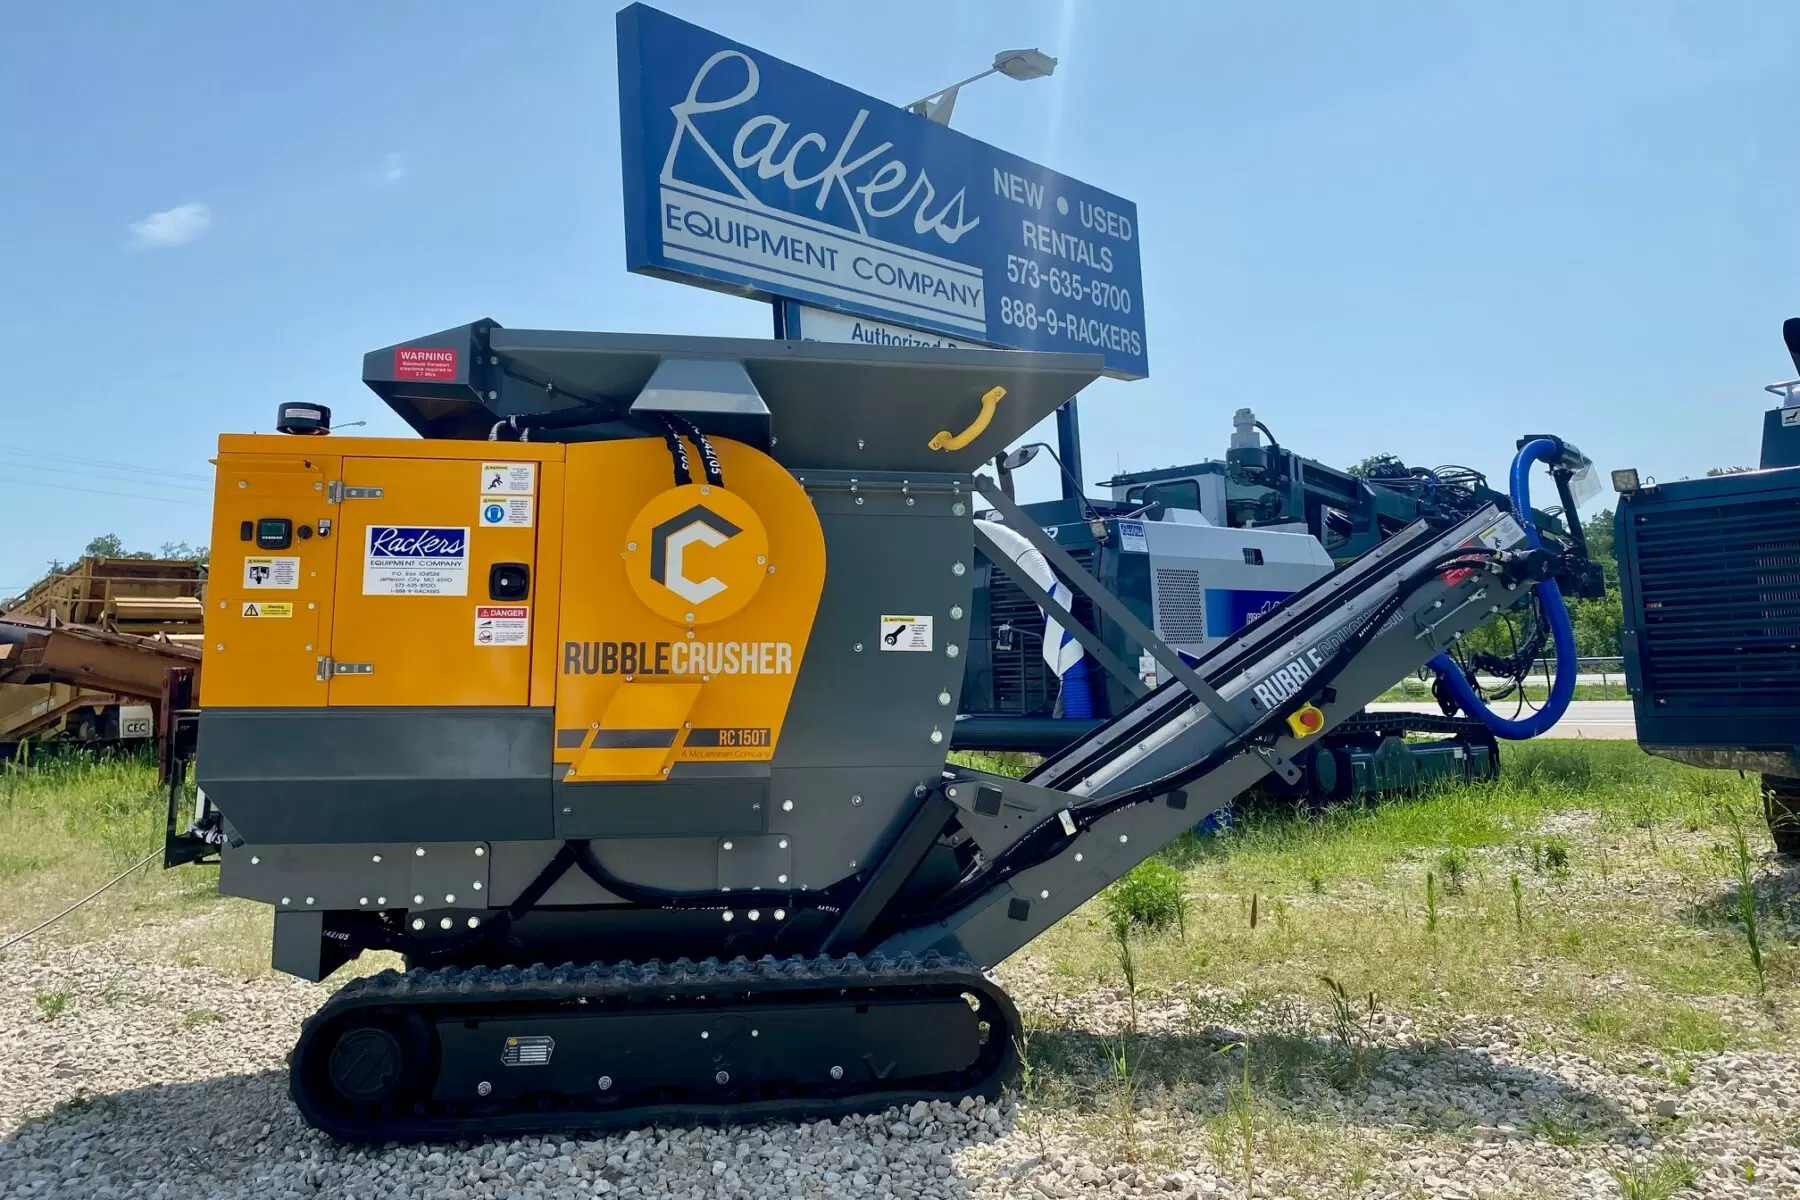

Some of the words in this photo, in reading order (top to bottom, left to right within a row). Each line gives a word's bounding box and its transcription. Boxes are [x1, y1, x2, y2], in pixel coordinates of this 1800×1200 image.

[660, 50, 980, 244] Rackers
[994, 168, 1043, 210] NEW
[1080, 204, 1132, 242] USED
[667, 203, 838, 272] EQUIPMENT
[853, 256, 981, 308] COMPANY
[1023, 220, 1113, 274] RENTALS
[1007, 254, 1131, 314] 573-635-8700
[1001, 296, 1141, 356] 888-9-RACKERS
[401, 352, 453, 361] WARNING
[371, 528, 464, 557] Rackers
[128, 723, 146, 732] CEC
